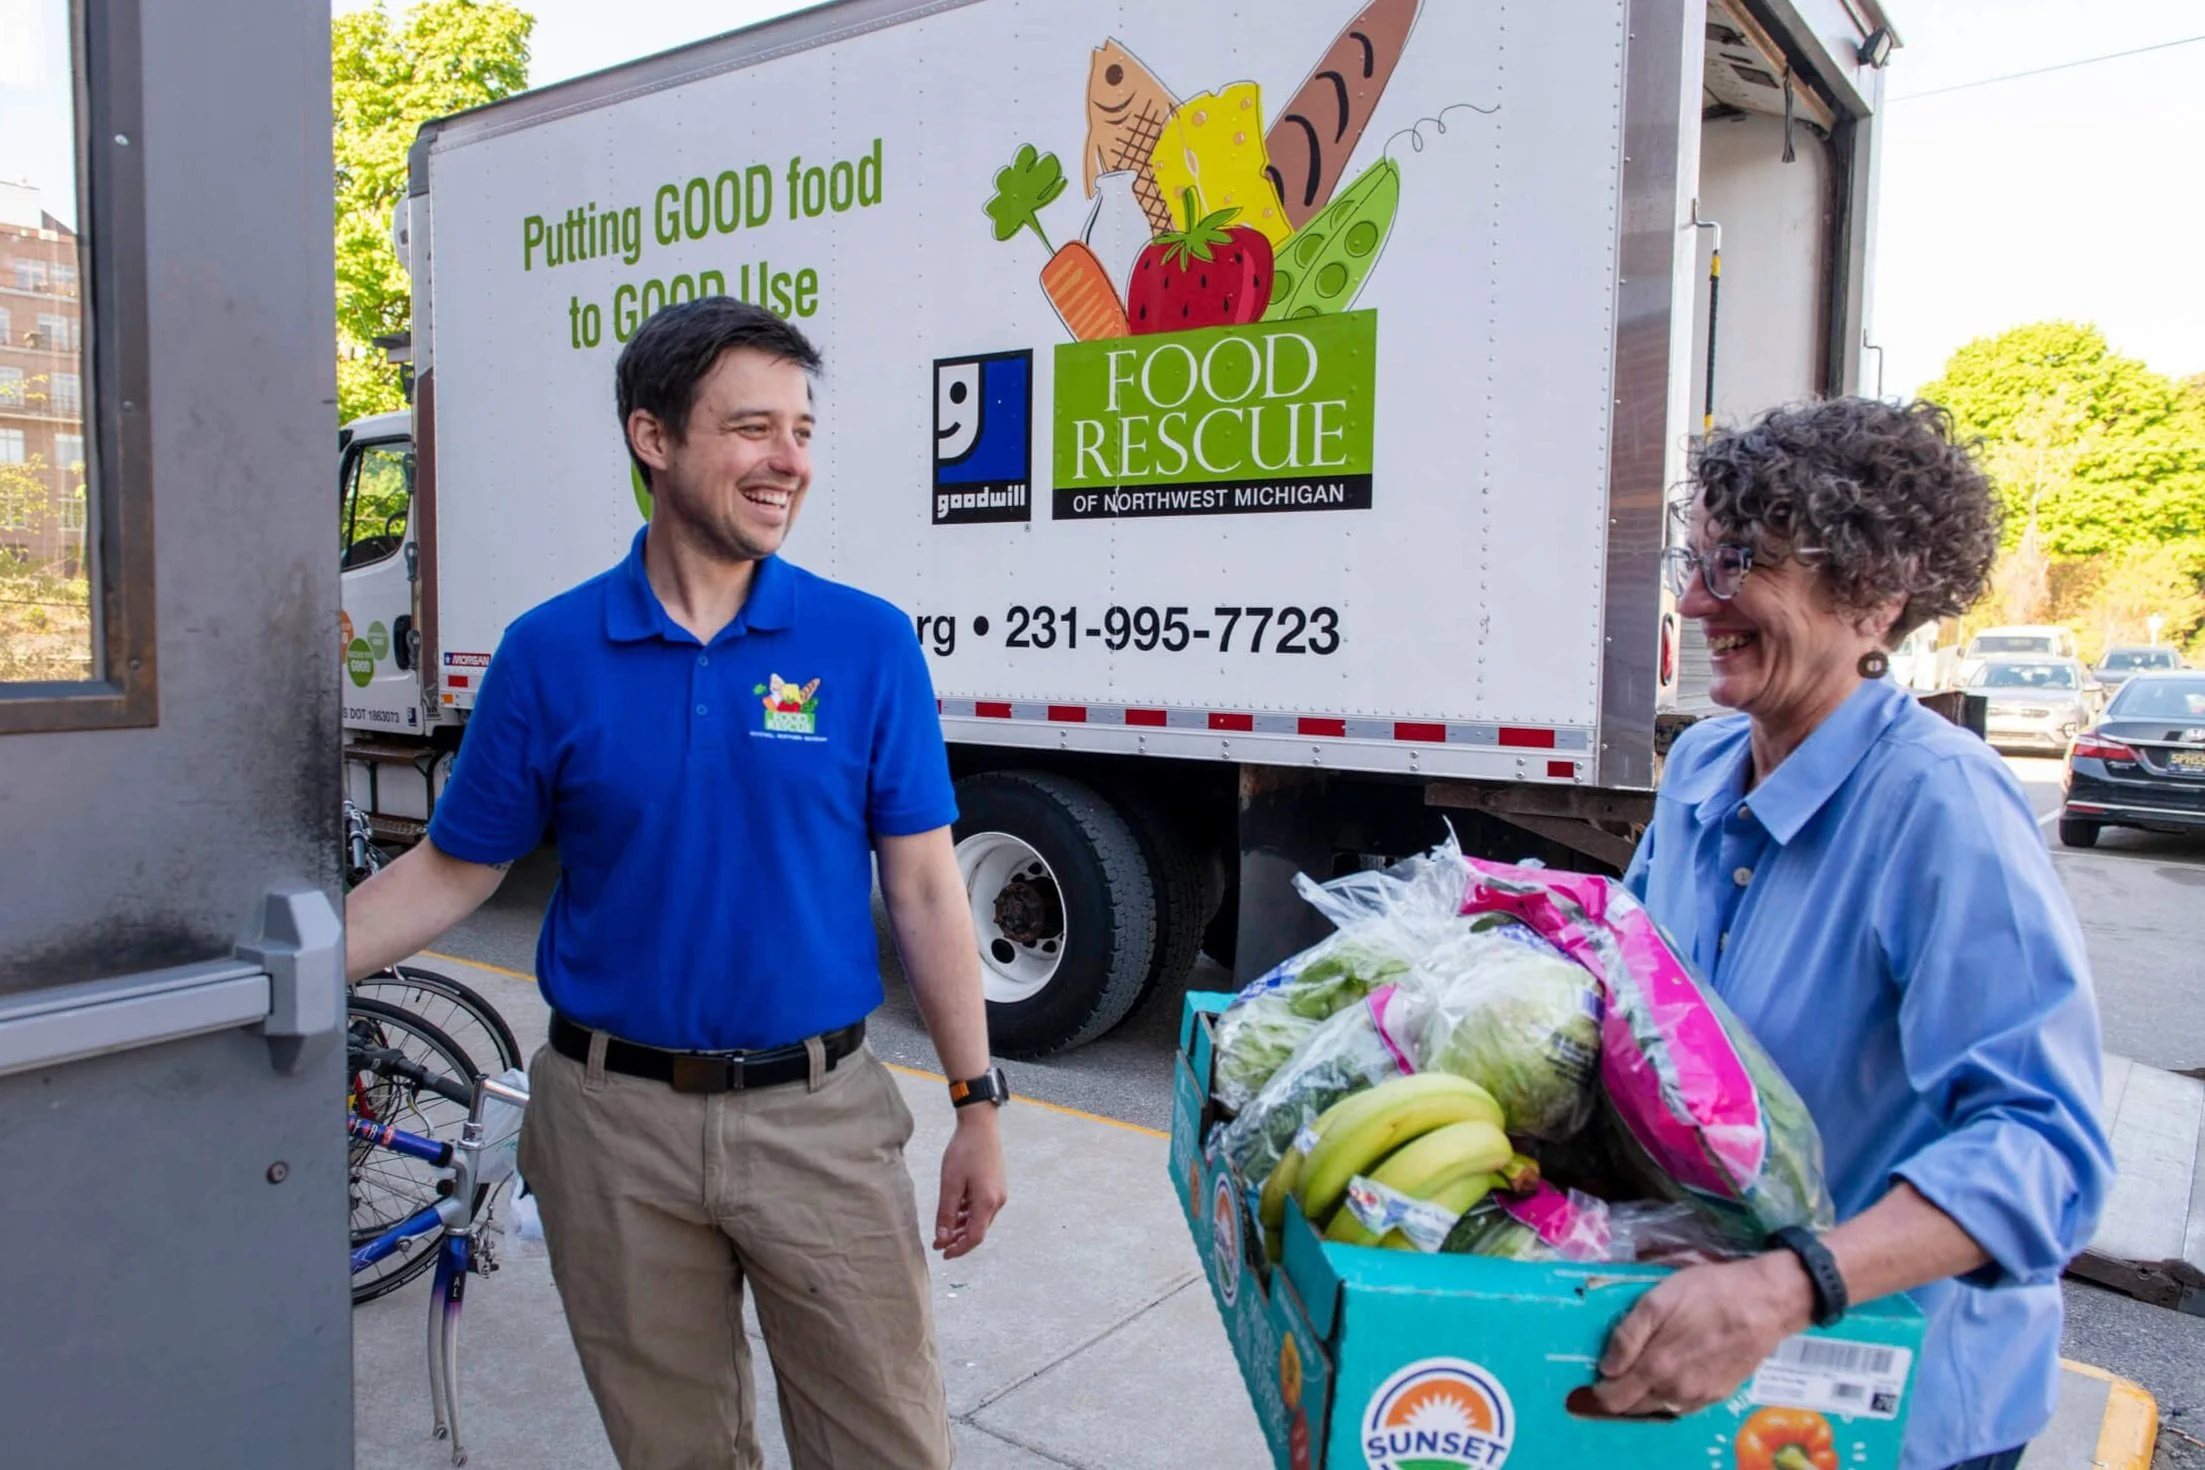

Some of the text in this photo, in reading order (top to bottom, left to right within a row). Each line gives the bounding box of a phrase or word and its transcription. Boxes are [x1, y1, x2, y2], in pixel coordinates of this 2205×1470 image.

[523, 138, 883, 271] Putting GOOD food
[569, 296, 601, 349] to
[741, 261, 818, 320] Use
[1104, 332, 1319, 412] FOOD
[1072, 400, 1348, 480] RESCUE
[937, 484, 1026, 519] goodwill
[1073, 483, 1345, 514] OF NORTHWEST MICHIGAN
[1005, 605, 1341, 655] 231-995-7723
[452, 655, 490, 666] MORGAN
[350, 708, 366, 720] DOT
[1367, 1430, 1506, 1465] SUNSET
